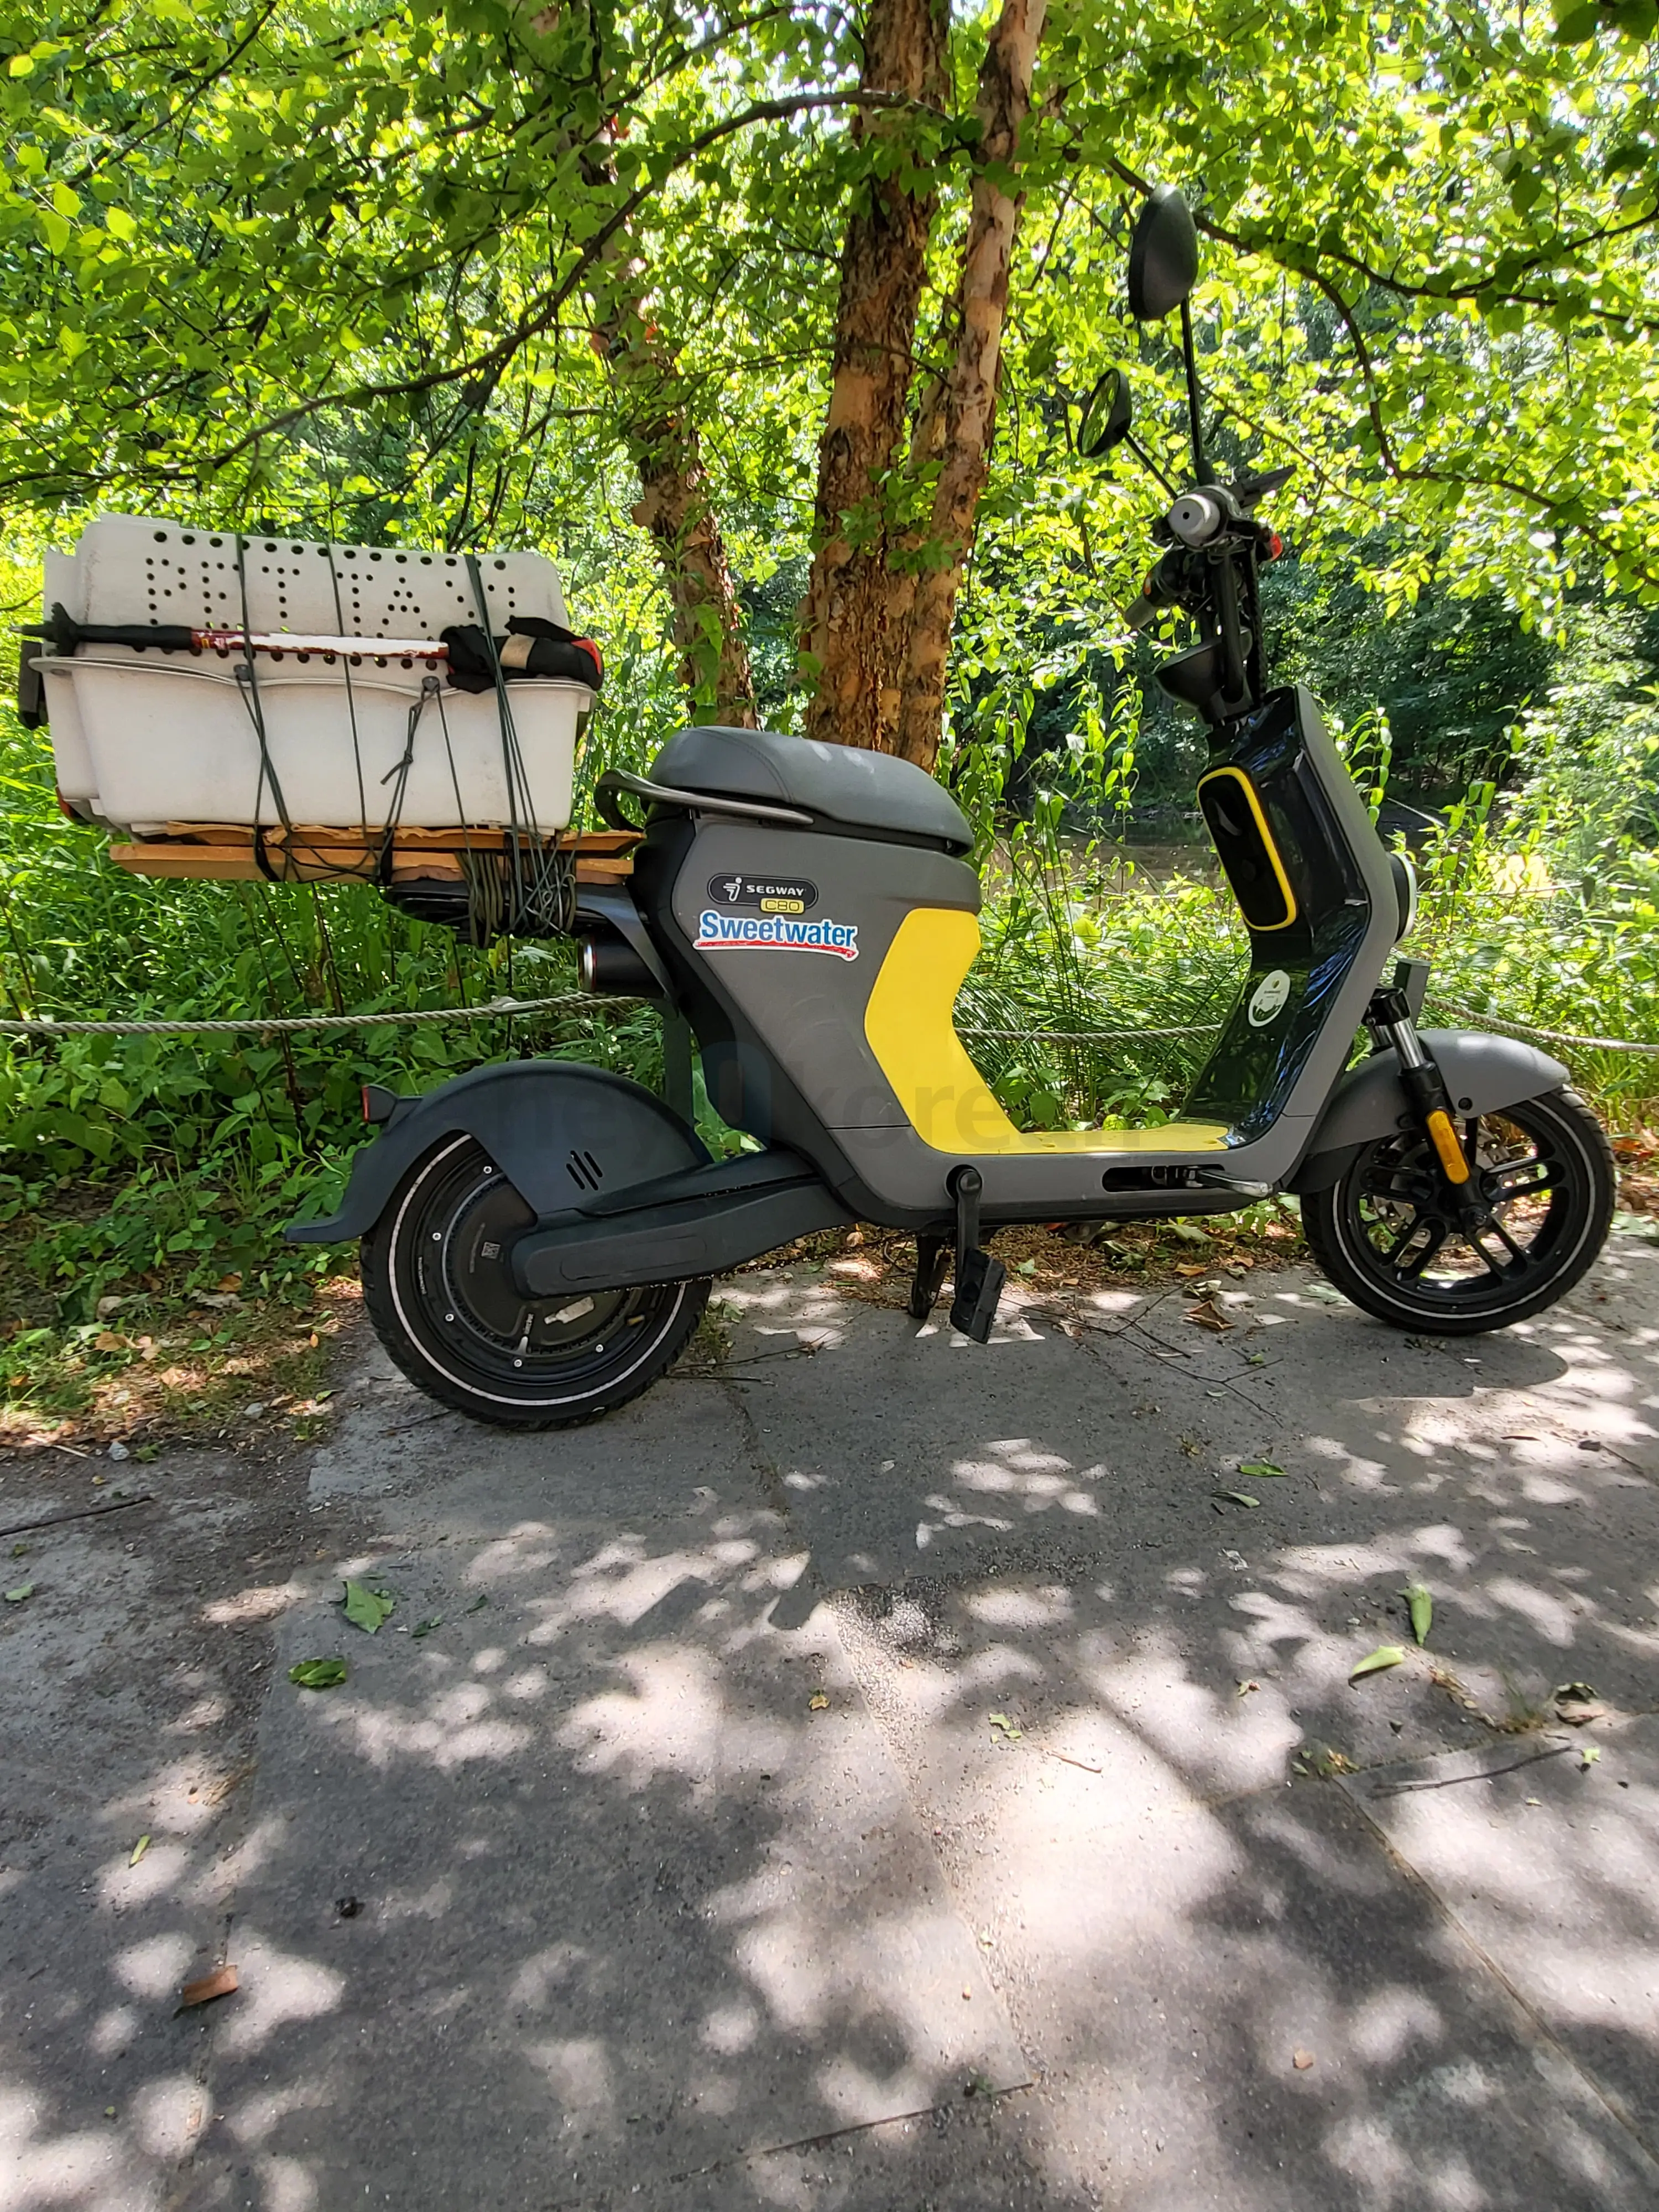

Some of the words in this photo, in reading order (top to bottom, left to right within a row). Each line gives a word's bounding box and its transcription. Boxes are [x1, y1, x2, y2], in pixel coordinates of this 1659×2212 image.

[746, 884, 804, 896] SEGWAY
[765, 899, 800, 912] C80
[701, 911, 855, 947] Sweetwater
